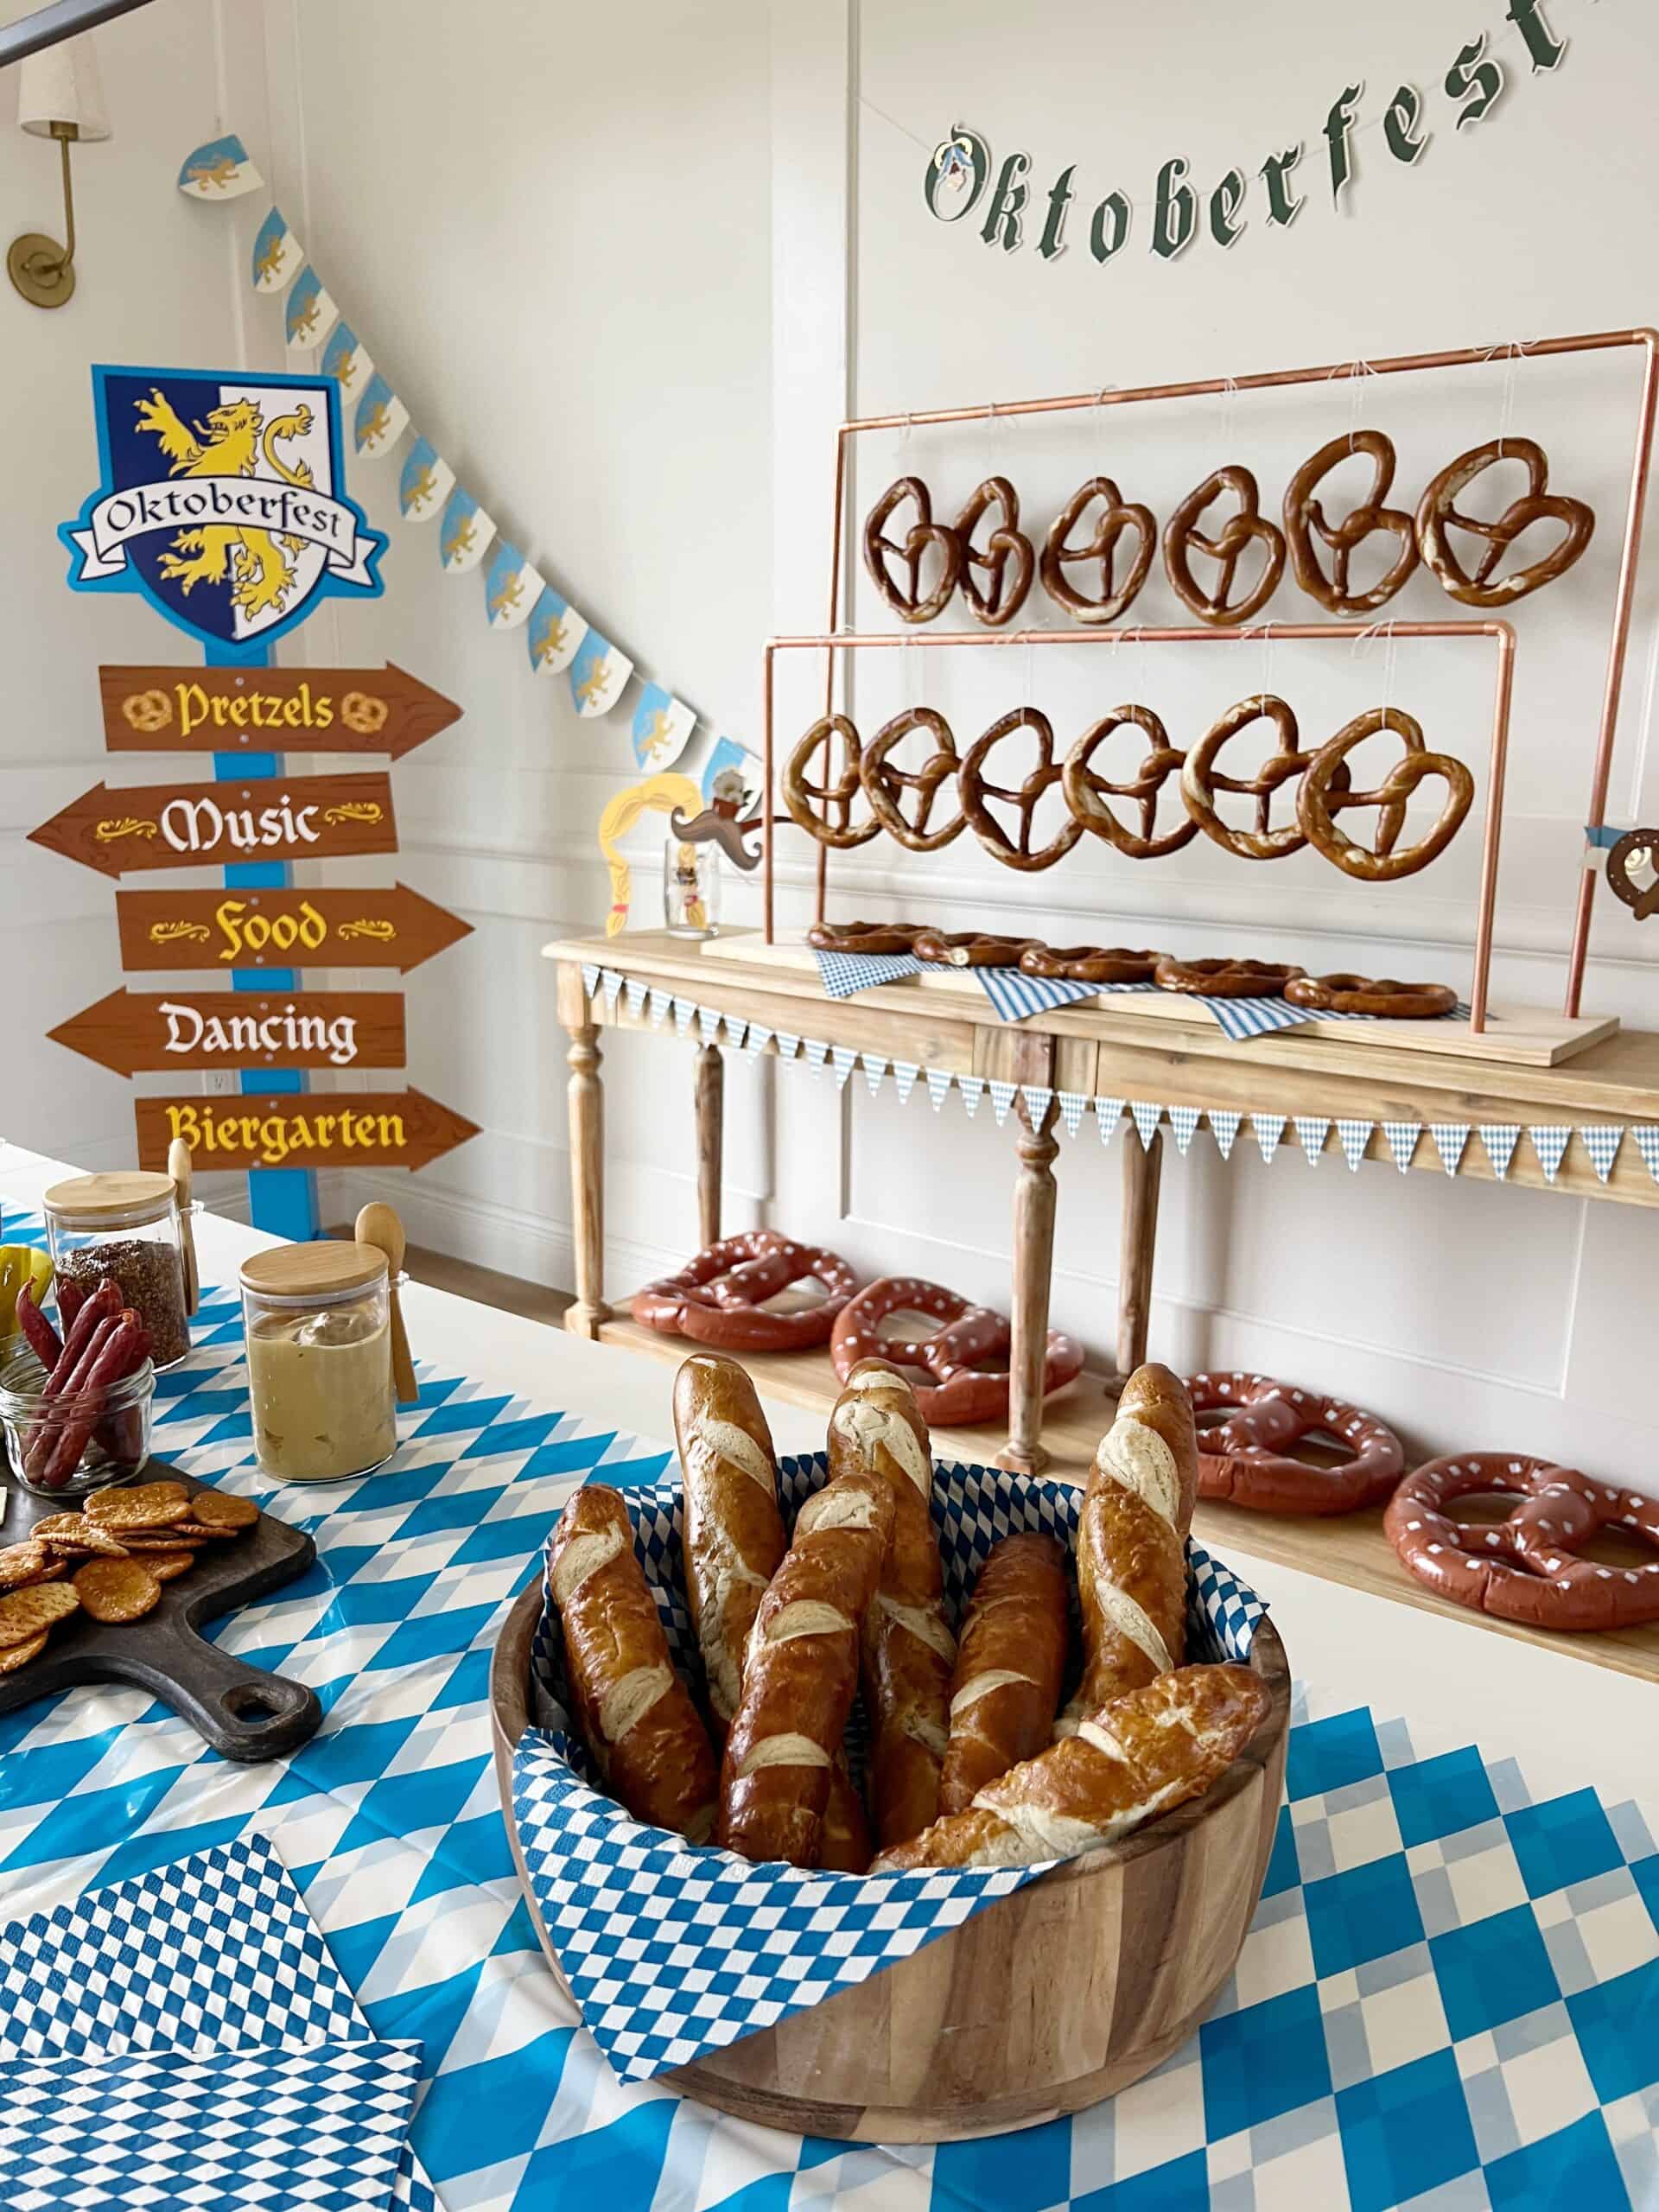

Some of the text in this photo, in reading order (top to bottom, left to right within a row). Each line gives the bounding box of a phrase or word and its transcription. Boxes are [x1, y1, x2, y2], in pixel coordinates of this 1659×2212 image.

[924, 0, 1570, 266] Oktoberfest
[106, 483, 342, 538] Oktoberfest
[175, 683, 334, 736] Pretzels
[161, 795, 321, 852] Music
[216, 900, 327, 960] Food
[158, 1001, 359, 1065] Dancing
[166, 1105, 407, 1163] Biergarten
